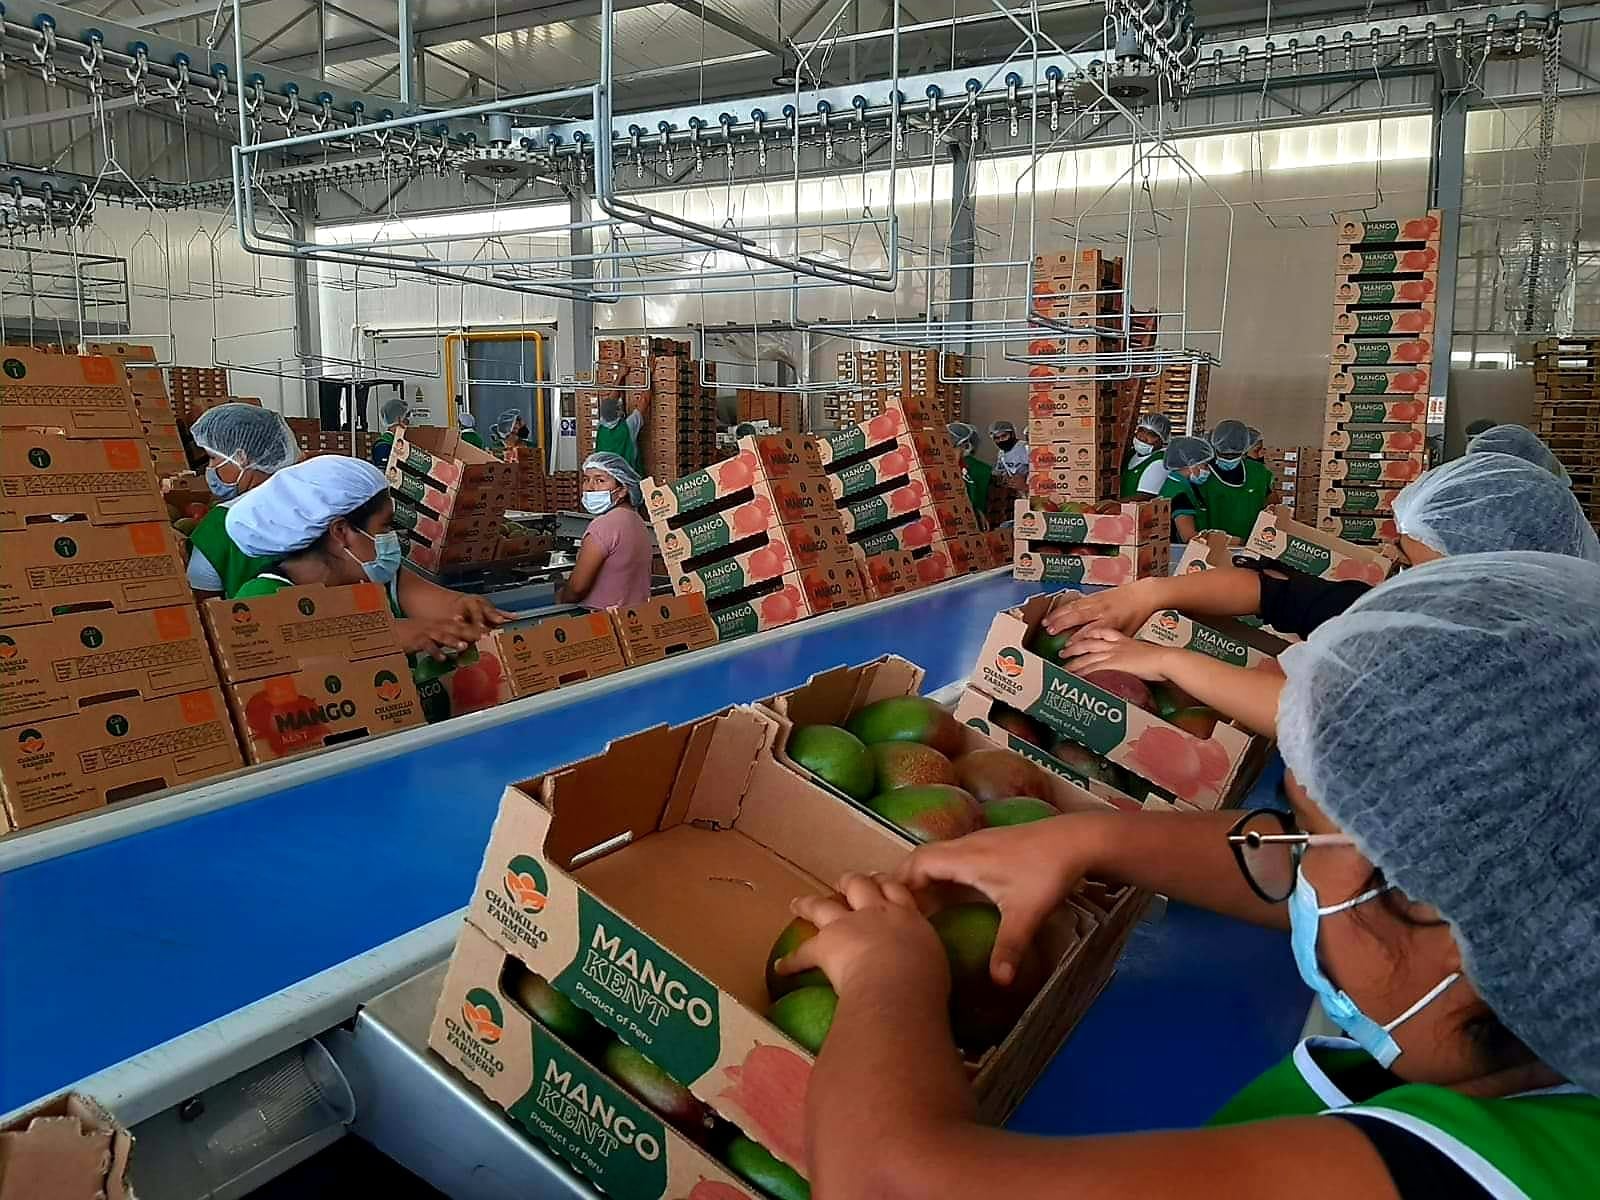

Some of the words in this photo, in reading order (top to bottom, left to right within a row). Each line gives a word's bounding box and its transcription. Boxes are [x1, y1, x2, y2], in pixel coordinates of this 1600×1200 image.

[831, 428, 861, 442] MANGO
[675, 474, 709, 494] MANGO
[842, 463, 871, 480] MANGO
[853, 499, 882, 515] MANGO
[1049, 517, 1084, 526] MANGO
[689, 518, 723, 537] MANGO
[864, 533, 894, 549] MANGO
[1046, 558, 1081, 567] MANGO
[1290, 540, 1329, 560] MANGO
[703, 562, 738, 580] MANGO
[717, 606, 752, 624] MANGO
[1197, 628, 1246, 656] MANGO
[420, 682, 441, 698] NGO
[1050, 677, 1122, 723] MANGO
[274, 699, 356, 733] MANGO
[1044, 691, 1097, 727] KENT
[485, 889, 548, 942] CHANKILLO
[487, 904, 539, 949] FARMERS
[582, 949, 670, 1027] KENT
[591, 923, 713, 1027] MANGO
[575, 982, 615, 1017] Product
[616, 1013, 629, 1025] of
[629, 1022, 653, 1044] Peru
[445, 1017, 504, 1072] CHANKILLO
[447, 1031, 496, 1078] FARMERS
[536, 1081, 619, 1157] KENT
[545, 1058, 660, 1161] MANGO
[530, 1111, 567, 1145] Product
[568, 1143, 580, 1154] of
[580, 1152, 603, 1174] Peru
